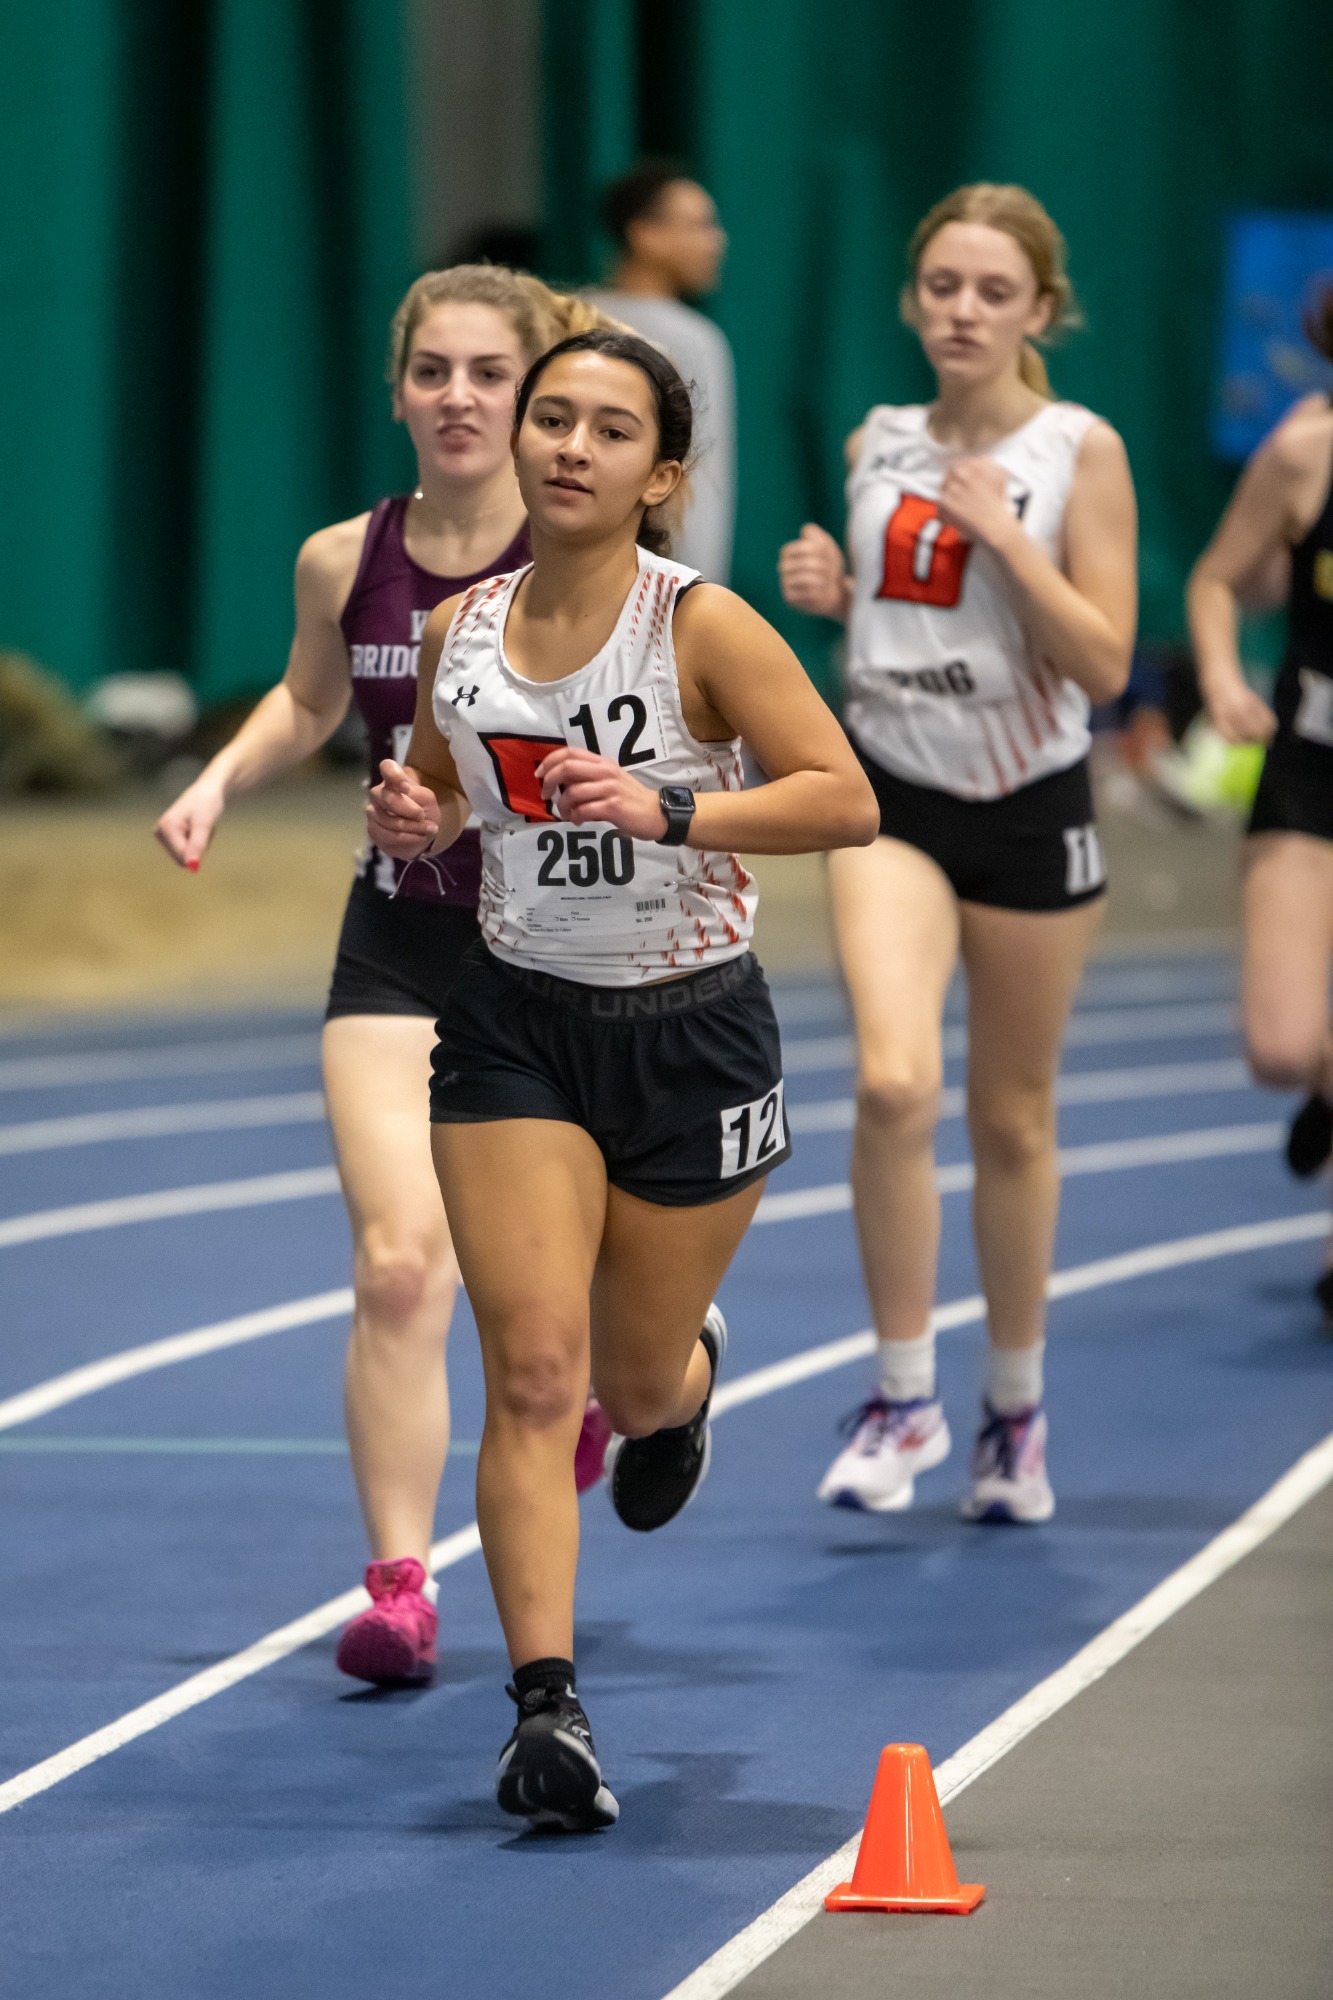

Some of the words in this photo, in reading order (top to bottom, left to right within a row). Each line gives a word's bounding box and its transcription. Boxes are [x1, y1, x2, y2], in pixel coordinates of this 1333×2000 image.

[568, 693, 657, 768] 12
[537, 829, 636, 888] 250
[591, 965, 742, 1018] UNDER
[730, 1090, 779, 1171] 12
